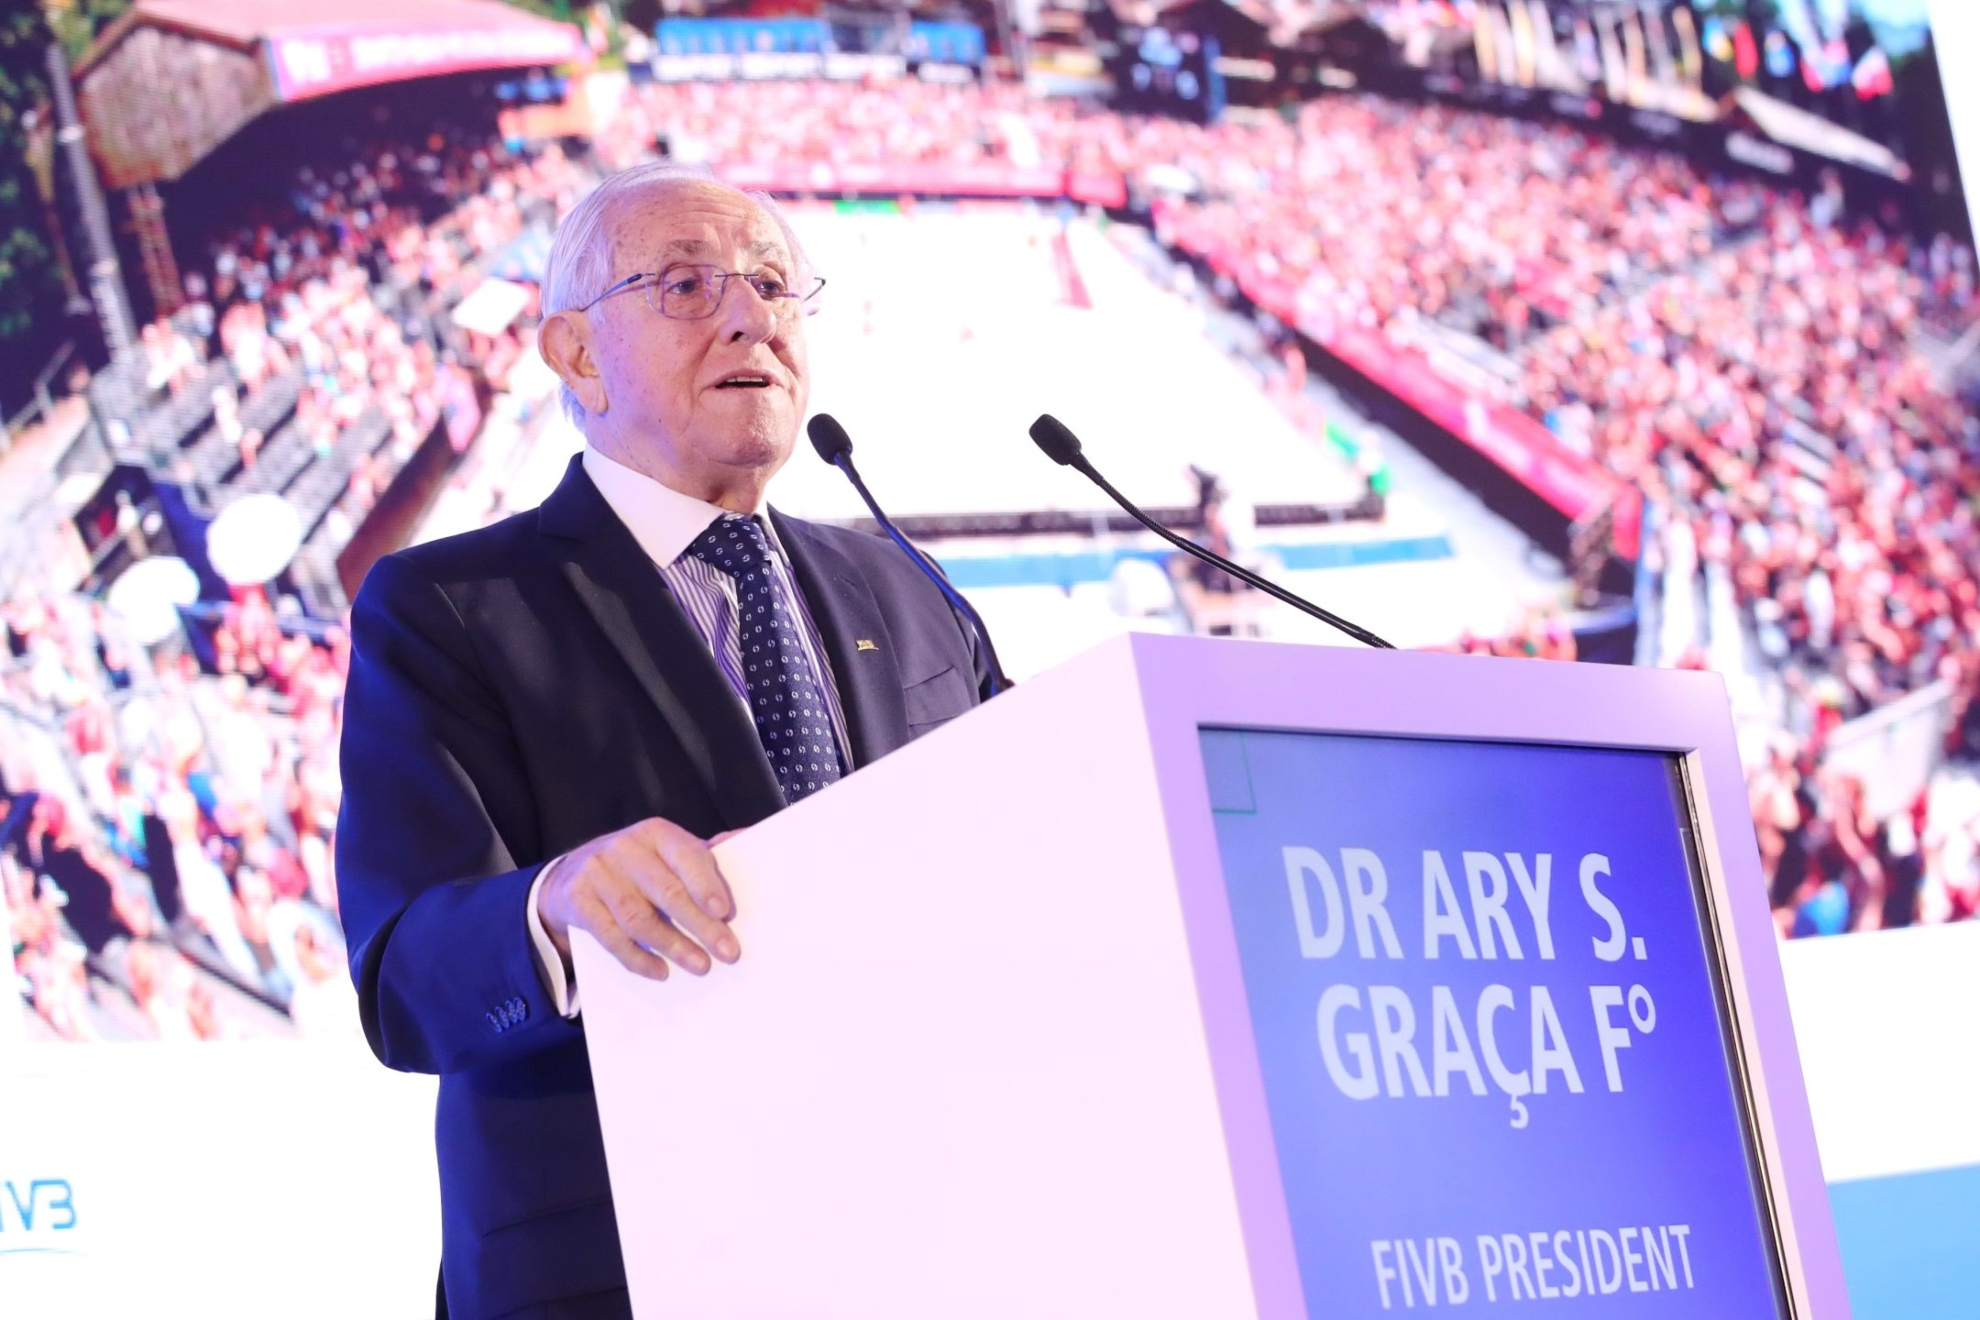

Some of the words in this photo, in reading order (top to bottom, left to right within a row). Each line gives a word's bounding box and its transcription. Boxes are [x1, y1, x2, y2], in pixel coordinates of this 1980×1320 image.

[1282, 846, 1404, 960] DR
[1422, 850, 1556, 960] ARY
[1579, 853, 1648, 962] S.
[1316, 984, 1585, 1129] GRAÇA
[1370, 1237, 1468, 1309] FIVB
[1478, 1225, 1695, 1301] PRESIDENT
